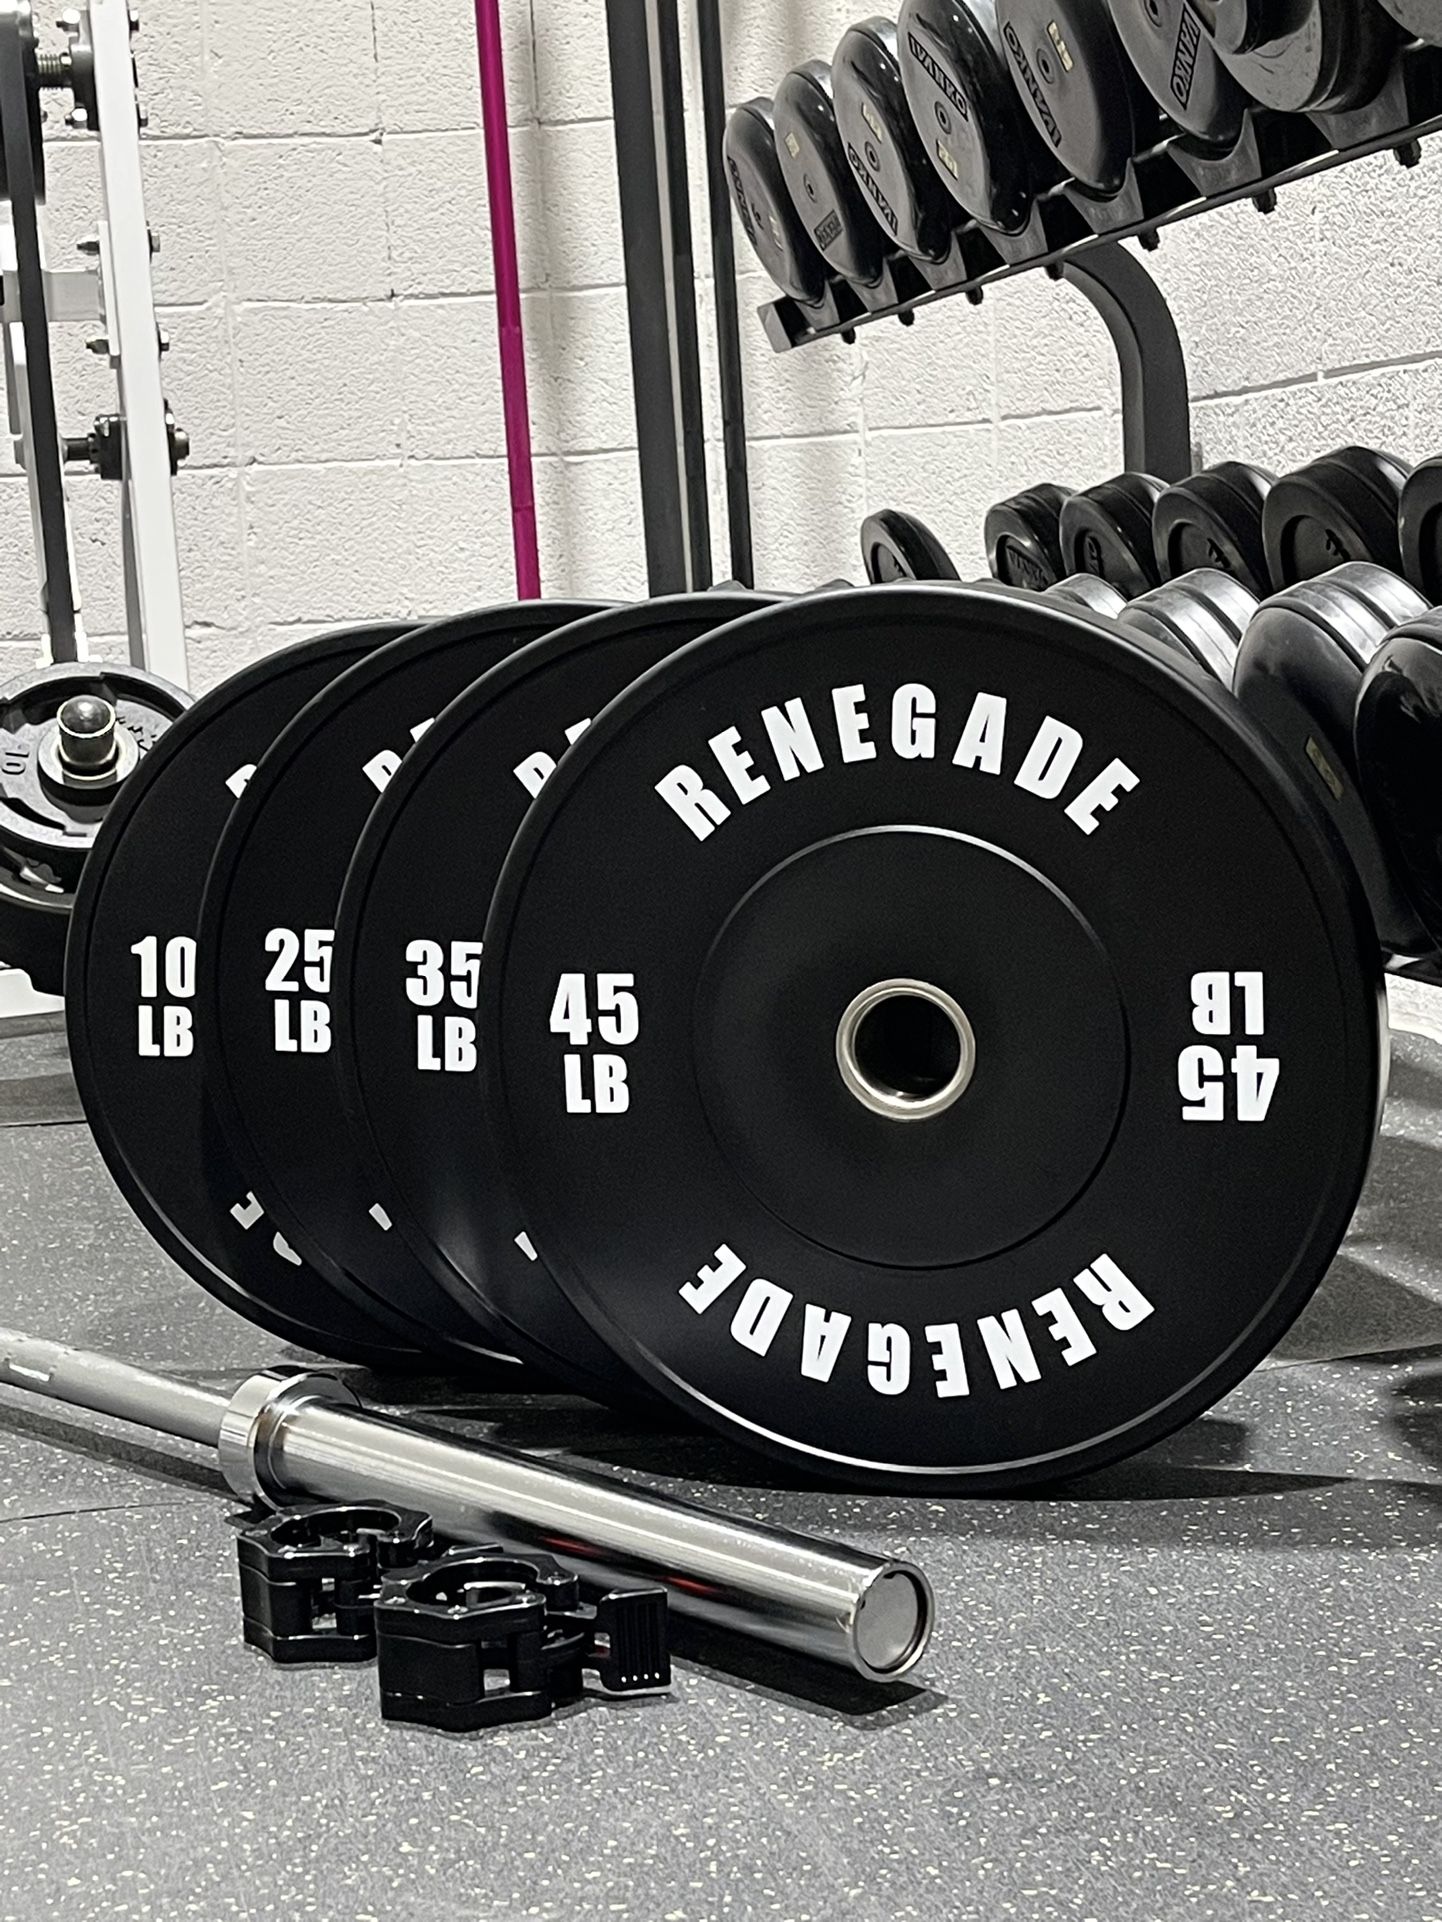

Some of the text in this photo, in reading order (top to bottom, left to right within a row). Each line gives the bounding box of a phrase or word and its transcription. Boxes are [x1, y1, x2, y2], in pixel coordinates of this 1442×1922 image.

[909, 34, 968, 119] IVANKO
[1004, 24, 1061, 146] IVANKO
[1172, 10, 1199, 106] VANKO
[655, 684, 1140, 841] RENEGADE
[131, 936, 197, 998] 10
[265, 928, 335, 993] 25
[406, 940, 483, 1009] 35
[138, 1005, 194, 1057] LB
[274, 999, 332, 1053] LB
[550, 974, 639, 1046] 45
[1190, 972, 1265, 1036] LB
[417, 1015, 477, 1072] LB
[563, 1054, 630, 1114] LB
[1178, 1045, 1280, 1121] 45
[679, 1244, 1154, 1397] RENEGADE
